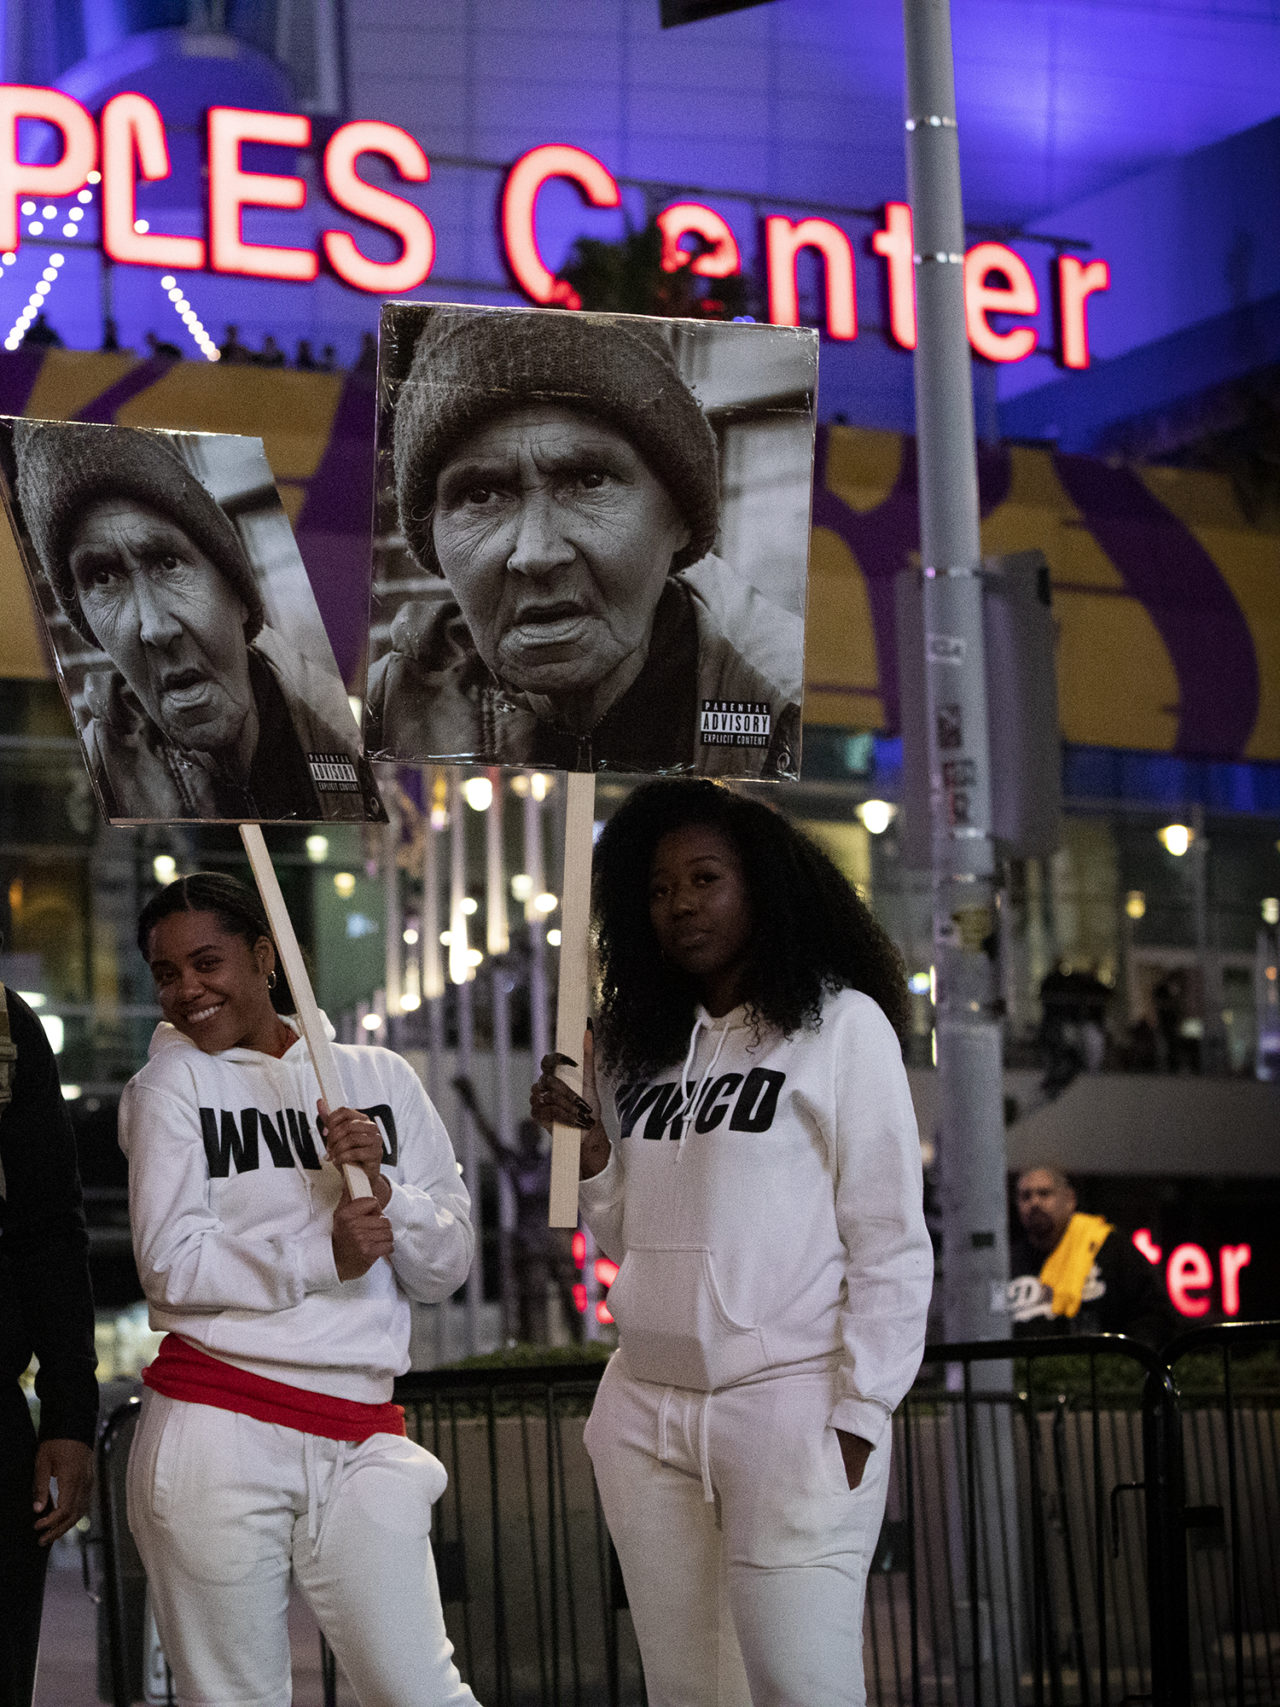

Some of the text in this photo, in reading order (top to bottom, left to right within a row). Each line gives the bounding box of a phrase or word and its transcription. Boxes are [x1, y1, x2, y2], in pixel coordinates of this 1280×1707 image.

[705, 701, 767, 713] PARENTAL
[703, 713, 768, 733] ADVISORY
[703, 733, 767, 746] EXPLICIT CONTENT
[198, 1104, 399, 1178] WWD
